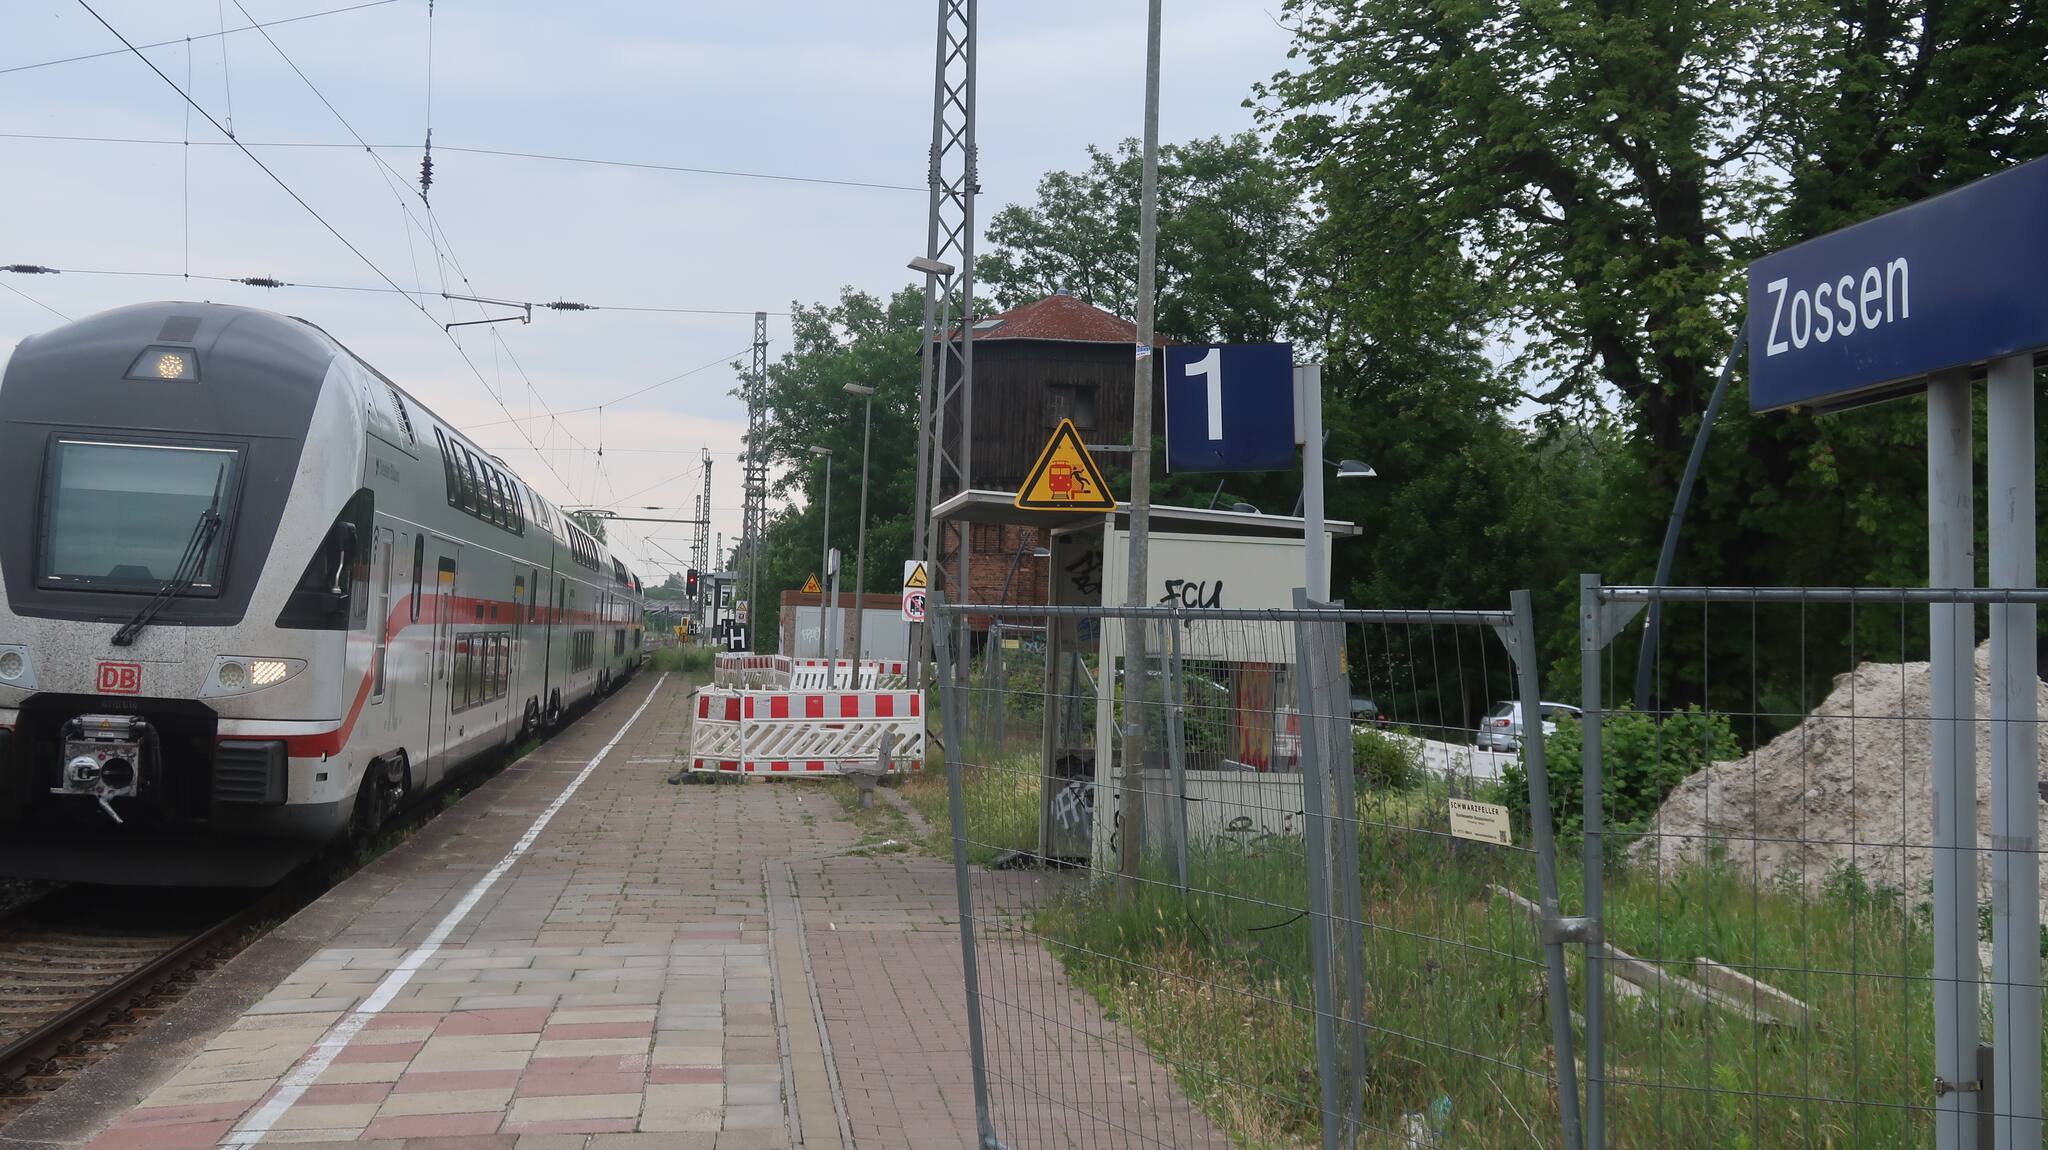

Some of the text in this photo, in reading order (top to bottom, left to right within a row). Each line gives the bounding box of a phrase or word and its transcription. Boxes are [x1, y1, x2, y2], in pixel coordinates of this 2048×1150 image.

[1767, 257, 1909, 357] Zossen
[1185, 348, 1222, 441] 1
[729, 628, 746, 649] H
[103, 667, 135, 688] DB
[1450, 801, 1500, 816] SCHWARZFELLER
